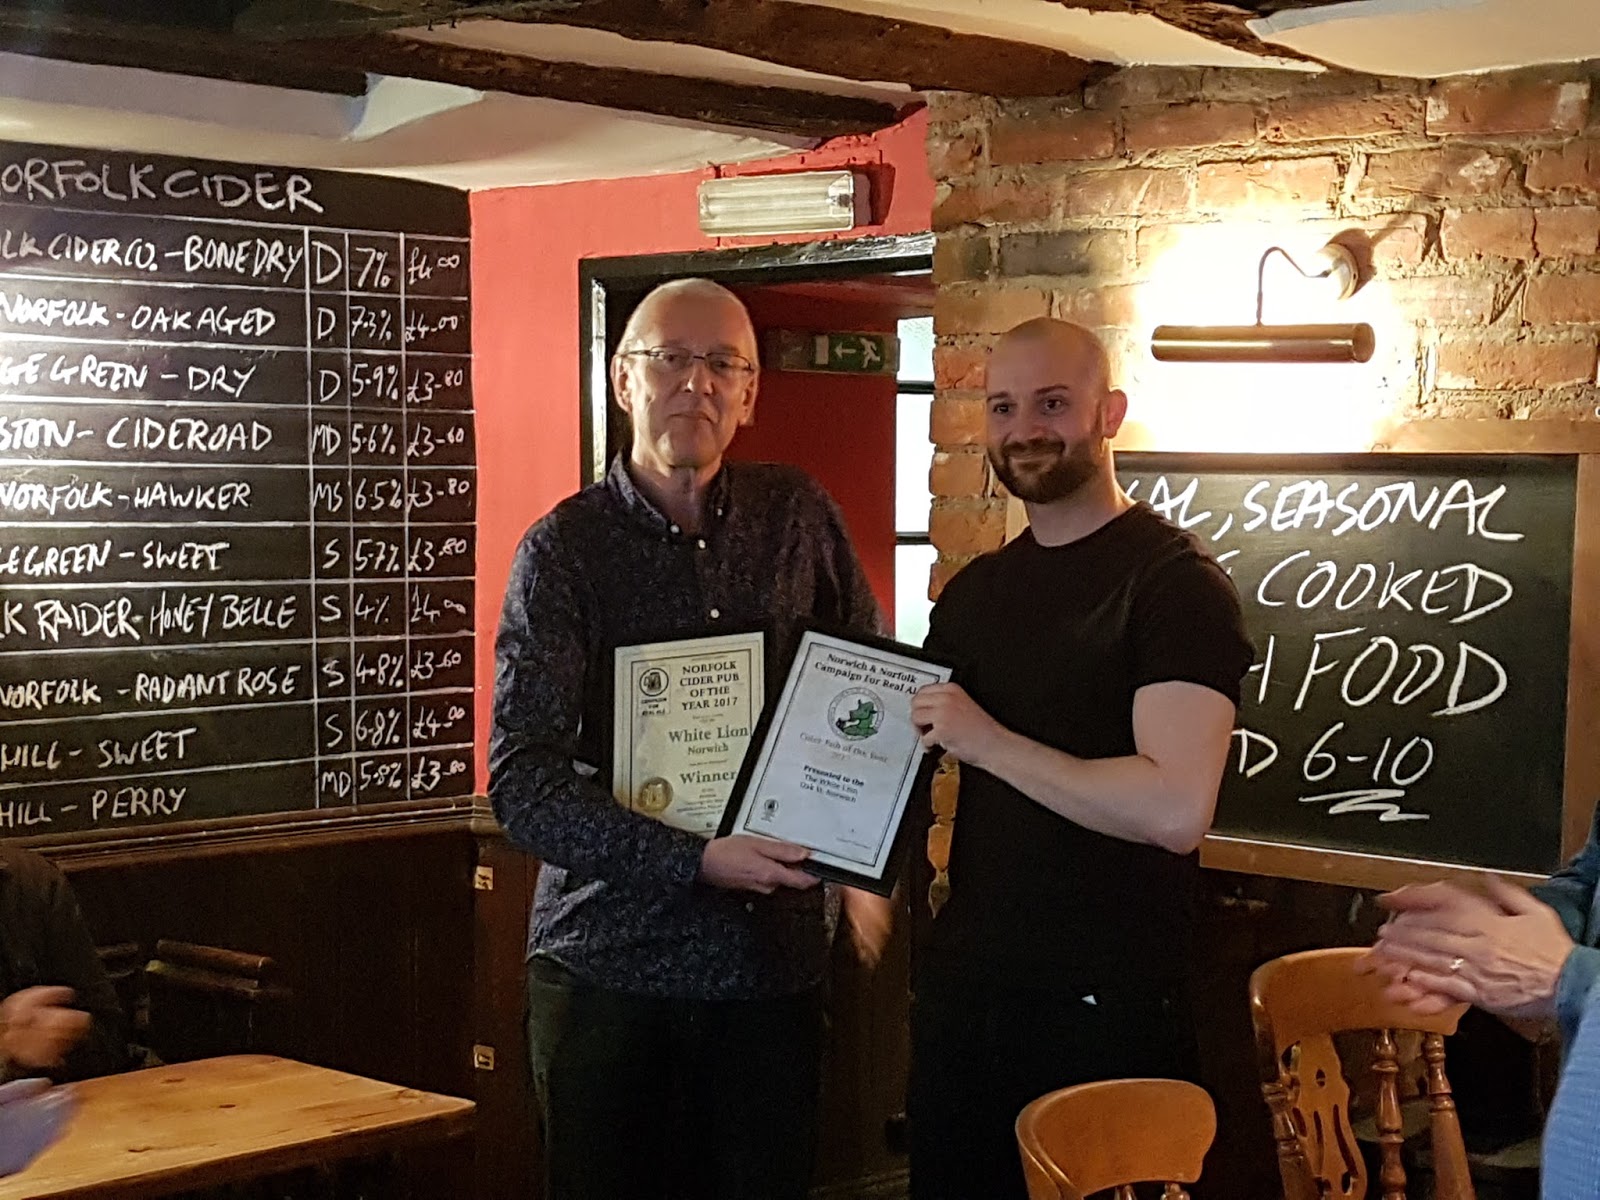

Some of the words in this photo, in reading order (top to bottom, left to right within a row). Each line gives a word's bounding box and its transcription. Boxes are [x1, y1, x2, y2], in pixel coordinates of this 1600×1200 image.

[1, 158, 156, 201] ORFOLK
[163, 169, 324, 214] CIDER
[311, 241, 342, 284] D
[356, 247, 391, 288] 7%
[317, 307, 336, 340] D
[50, 354, 148, 391] GREEN
[188, 364, 257, 398] DRY
[319, 369, 341, 401] D
[312, 423, 341, 457] MD
[134, 481, 252, 511] HAWKER
[312, 481, 343, 512] MS
[1243, 478, 1525, 542] SEASONAL
[143, 541, 231, 571] SWEET
[322, 538, 341, 569] S
[1257, 550, 1513, 624] COOKED
[150, 590, 214, 639] HONEY
[220, 595, 297, 630] BELLE
[320, 595, 342, 623] S
[355, 593, 391, 624] 4%
[135, 671, 230, 704] RADIANT
[237, 665, 302, 698] ROSE
[322, 659, 345, 688] S
[680, 675, 714, 687] CIDER
[717, 673, 740, 683] PUB
[682, 660, 737, 675] NORFOLK
[814, 660, 862, 681] Campaign
[863, 673, 881, 686] for
[882, 679, 905, 692] Real
[827, 653, 868, 671] Norwich
[880, 666, 917, 684] Norfolk
[1293, 626, 1508, 717] FOOD
[681, 700, 710, 712] YEAR
[714, 696, 738, 708] 2017
[690, 687, 706, 698] OF
[706, 685, 730, 698] THE
[97, 727, 198, 769] SWEET
[325, 713, 344, 748] S
[668, 727, 712, 744] White
[717, 724, 749, 739] Lion
[687, 742, 730, 756] Norwich
[1303, 721, 1434, 786] 6-10
[680, 770, 737, 785] Winner
[92, 786, 187, 820] PERRY
[321, 771, 351, 798] MD
